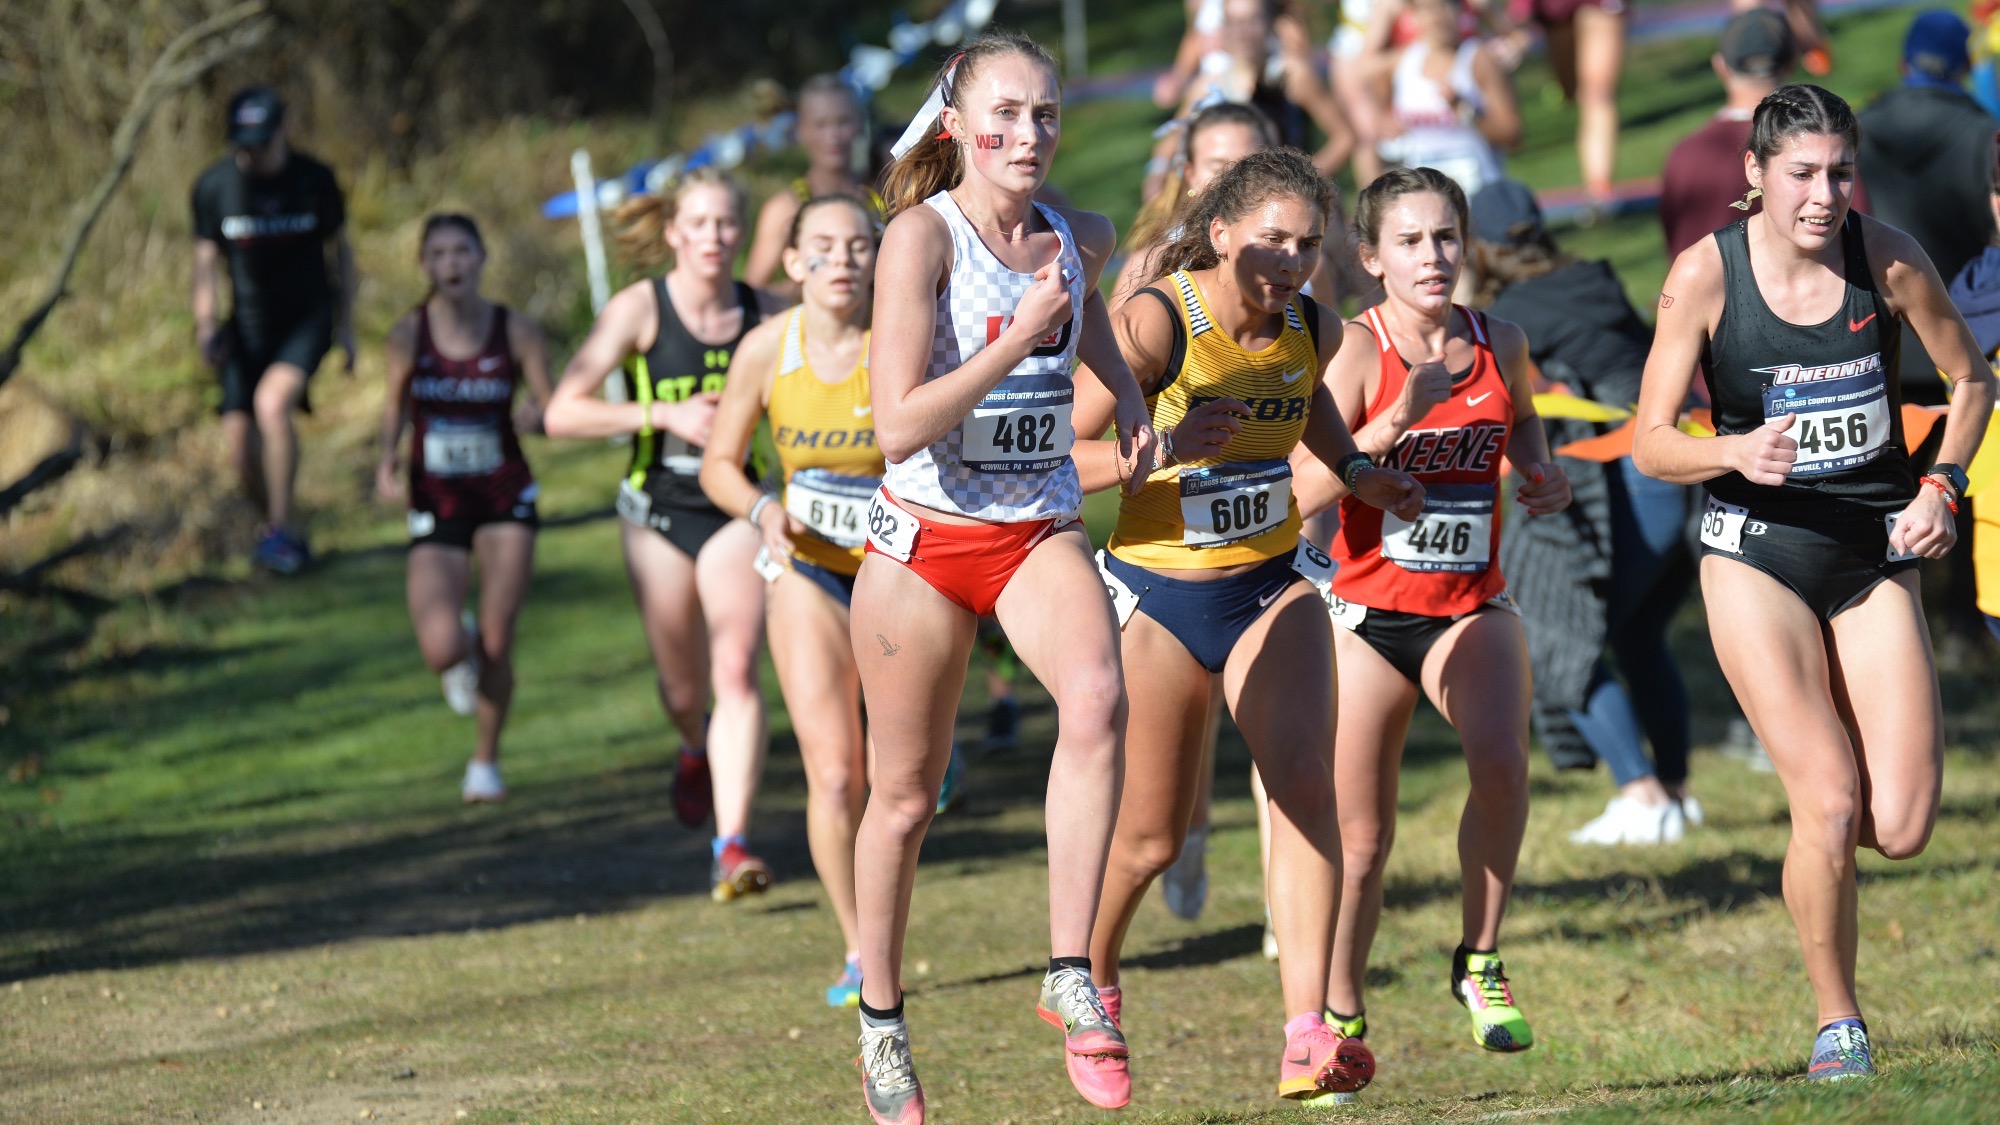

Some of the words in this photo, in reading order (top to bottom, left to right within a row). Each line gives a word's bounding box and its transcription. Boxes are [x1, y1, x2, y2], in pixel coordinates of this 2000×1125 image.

[1760, 353, 1880, 386] ONEONTA
[1007, 391, 1034, 400] COUNTRY
[1786, 400, 1806, 408] CROSS
[1808, 396, 1836, 405] COUNTRY
[1837, 383, 1885, 402] CHAMPIONSHIPS
[992, 413, 1056, 453] 482
[1383, 426, 1507, 473] KEENE
[1799, 412, 1868, 454] 456
[1200, 480, 1219, 488] CROSS
[1220, 474, 1246, 484] COUNTRY
[1246, 465, 1289, 479] CHAMPIONSHIPS
[1843, 458, 1857, 466] NOV
[810, 500, 858, 531] 614
[1211, 491, 1270, 534] 608
[1408, 520, 1472, 555] 446
